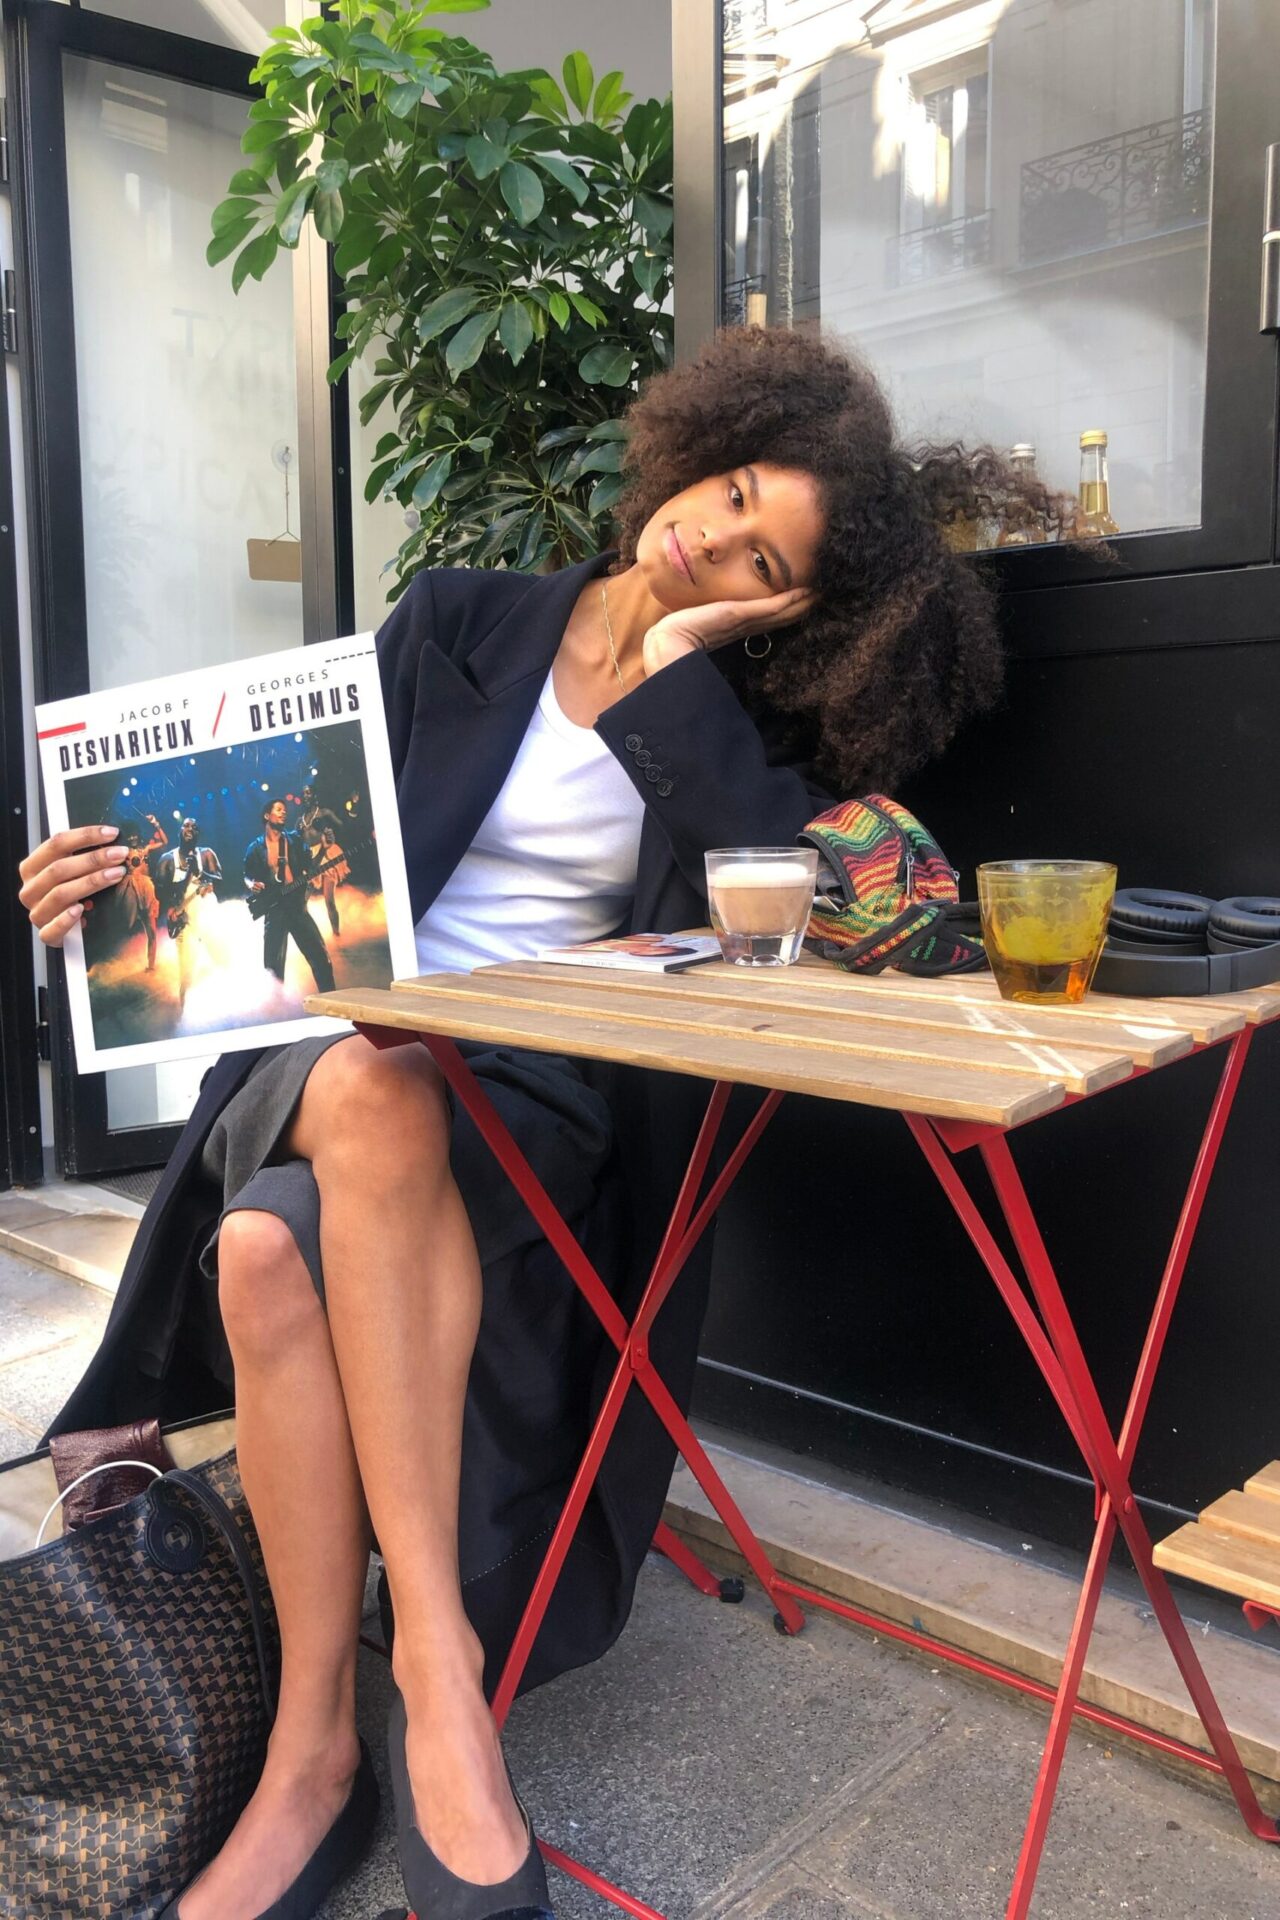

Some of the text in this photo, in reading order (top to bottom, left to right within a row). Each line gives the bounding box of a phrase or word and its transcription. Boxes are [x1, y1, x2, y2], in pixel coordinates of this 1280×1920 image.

[246, 669, 330, 697] GEORGES
[118, 698, 191, 725] JACOB F
[249, 683, 360, 733] DECIMUS
[58, 718, 194, 773] DESVARIEUX
